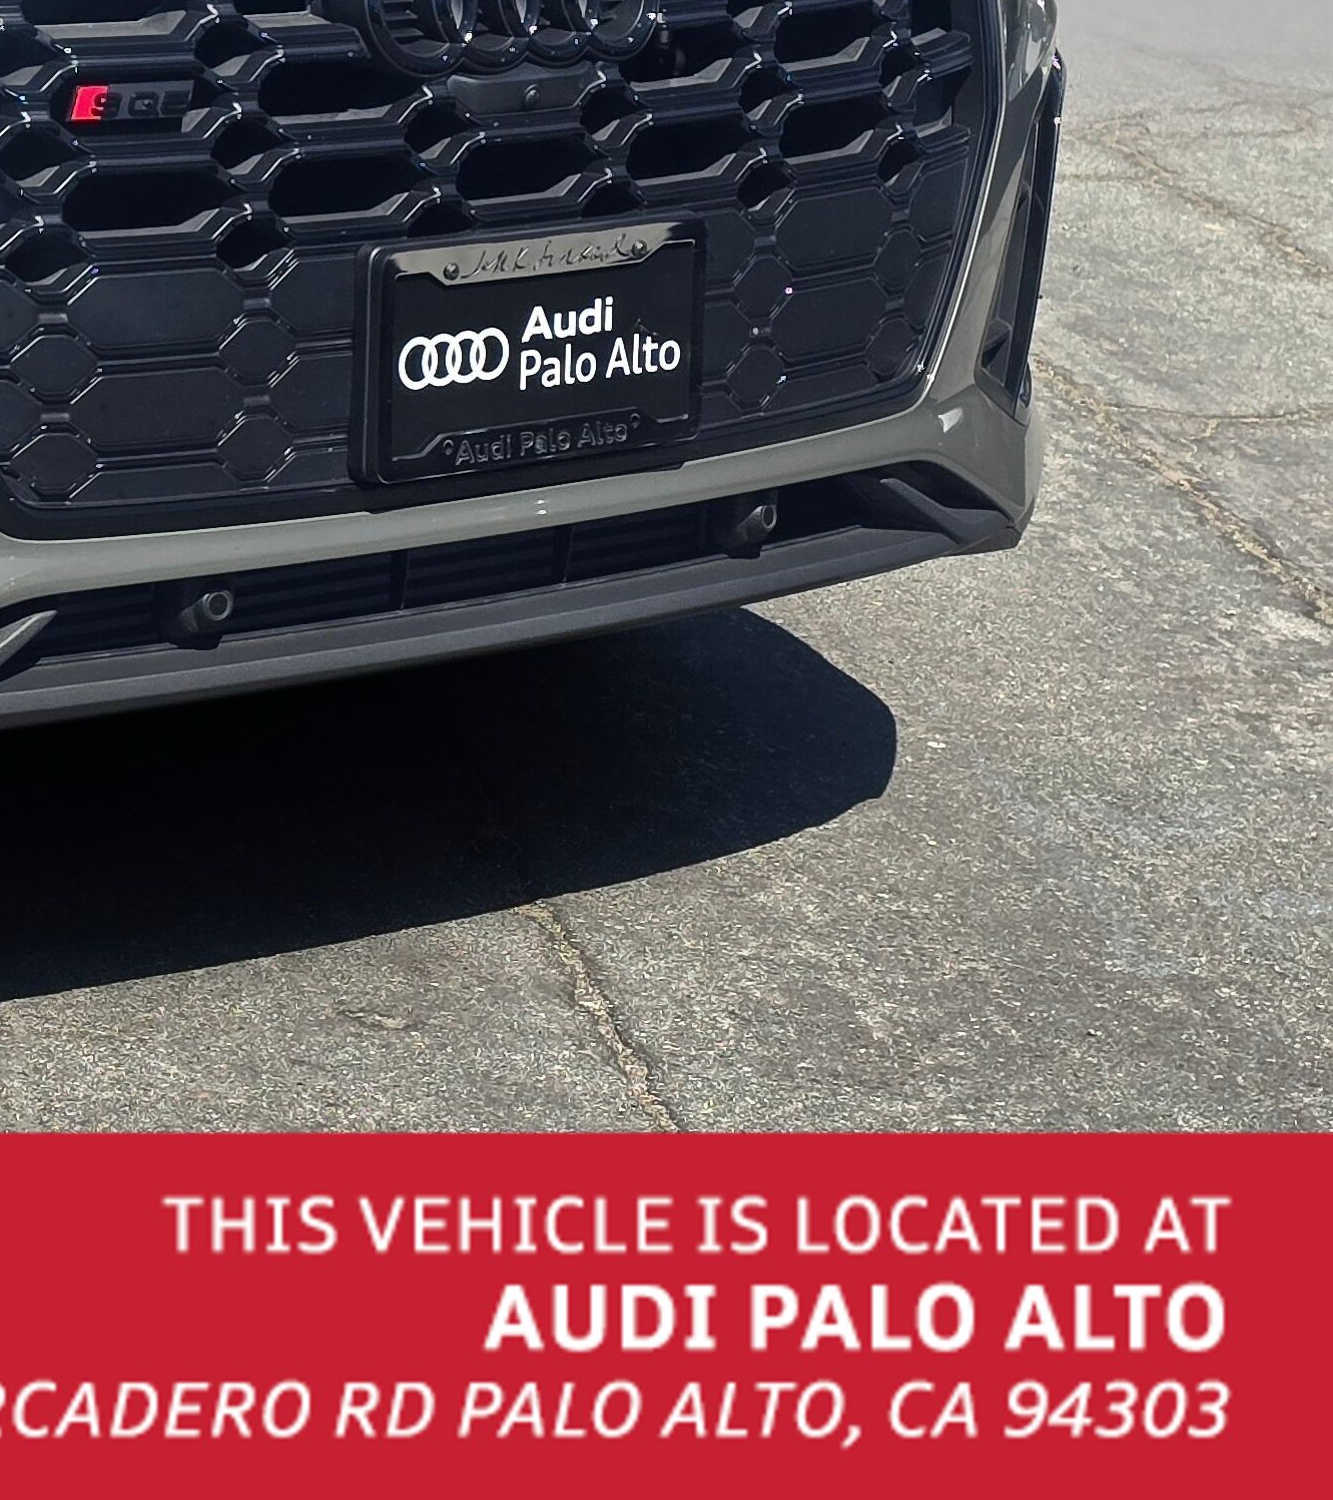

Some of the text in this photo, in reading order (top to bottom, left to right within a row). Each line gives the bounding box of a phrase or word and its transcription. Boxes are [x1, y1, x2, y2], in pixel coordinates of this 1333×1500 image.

[521, 296, 614, 343] Audi
[519, 333, 681, 391] Palo Alto
[455, 419, 629, 466] Audi Palo Alto
